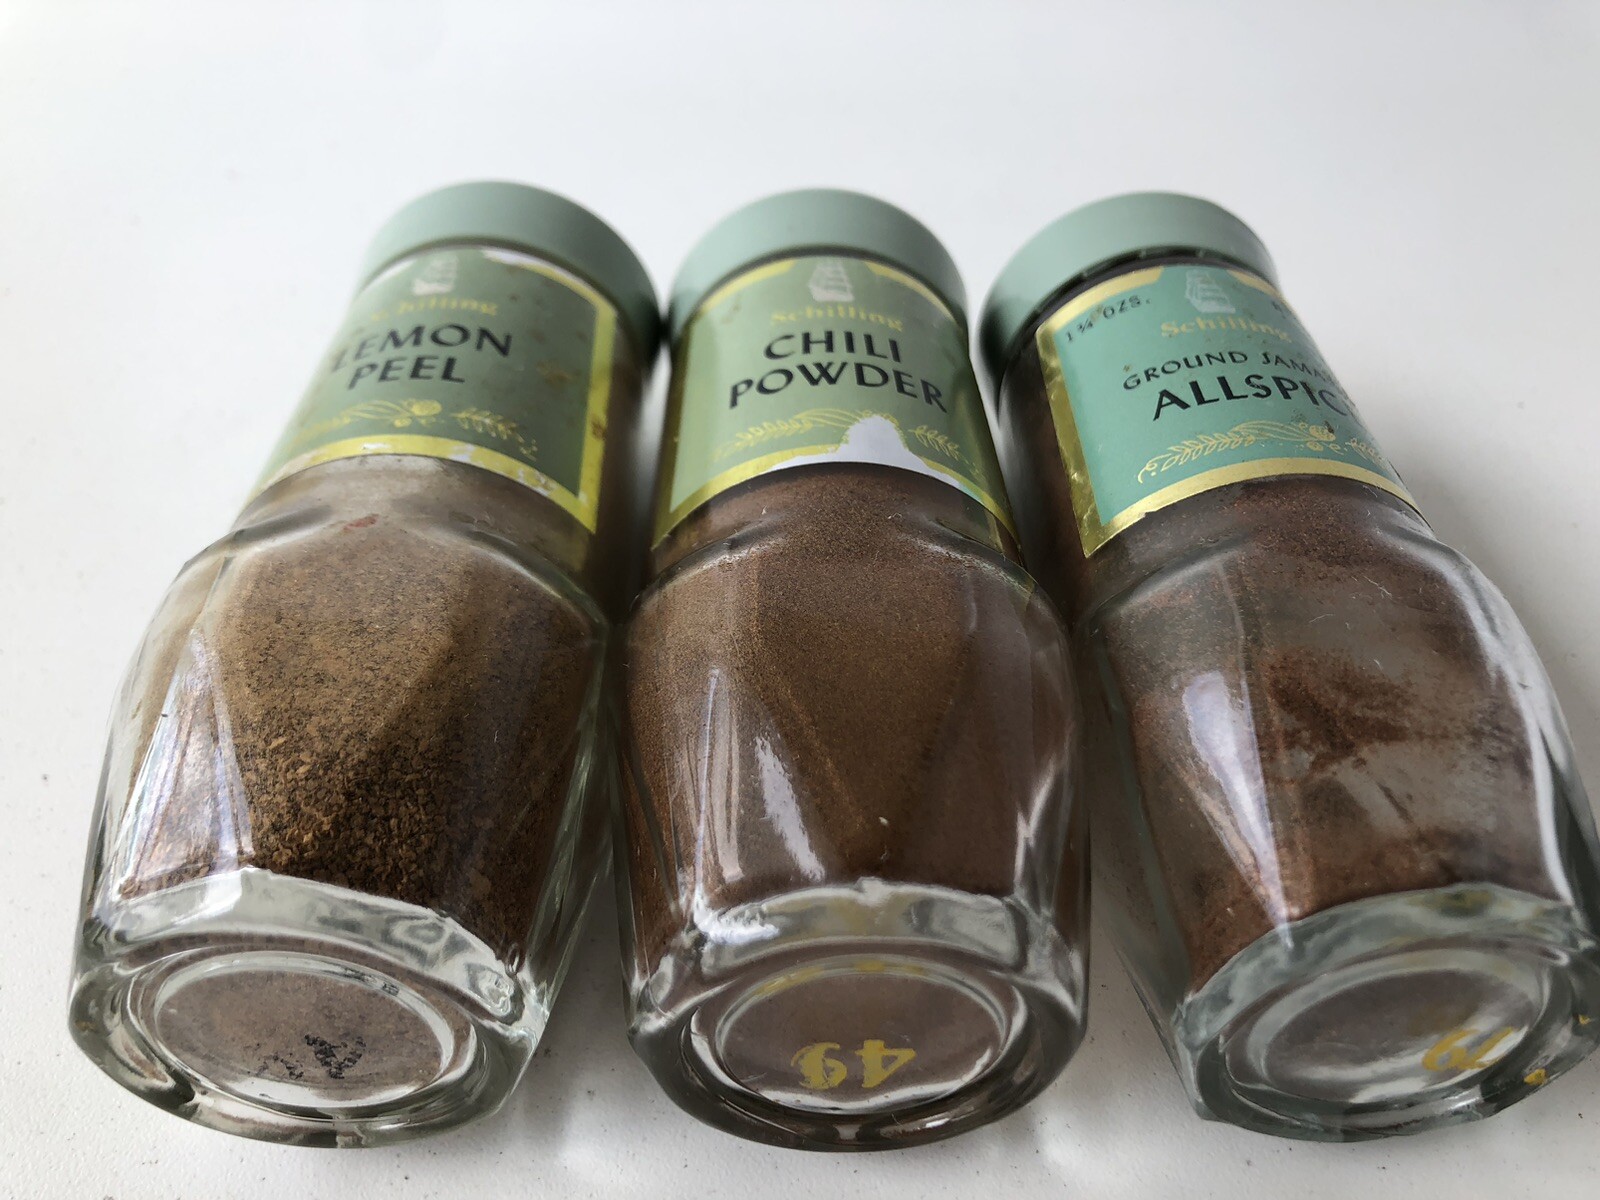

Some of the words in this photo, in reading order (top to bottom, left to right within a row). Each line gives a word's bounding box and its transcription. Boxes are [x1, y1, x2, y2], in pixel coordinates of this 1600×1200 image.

[770, 303, 904, 333] Schilling
[1160, 315, 1293, 344] Schilling
[330, 323, 513, 374] LEMON
[764, 329, 902, 363] CHILI
[346, 355, 466, 391] PEEL
[728, 361, 948, 414] POWDER
[1122, 350, 1248, 391] GROUND
[1152, 373, 1355, 422] ALLSPIC
